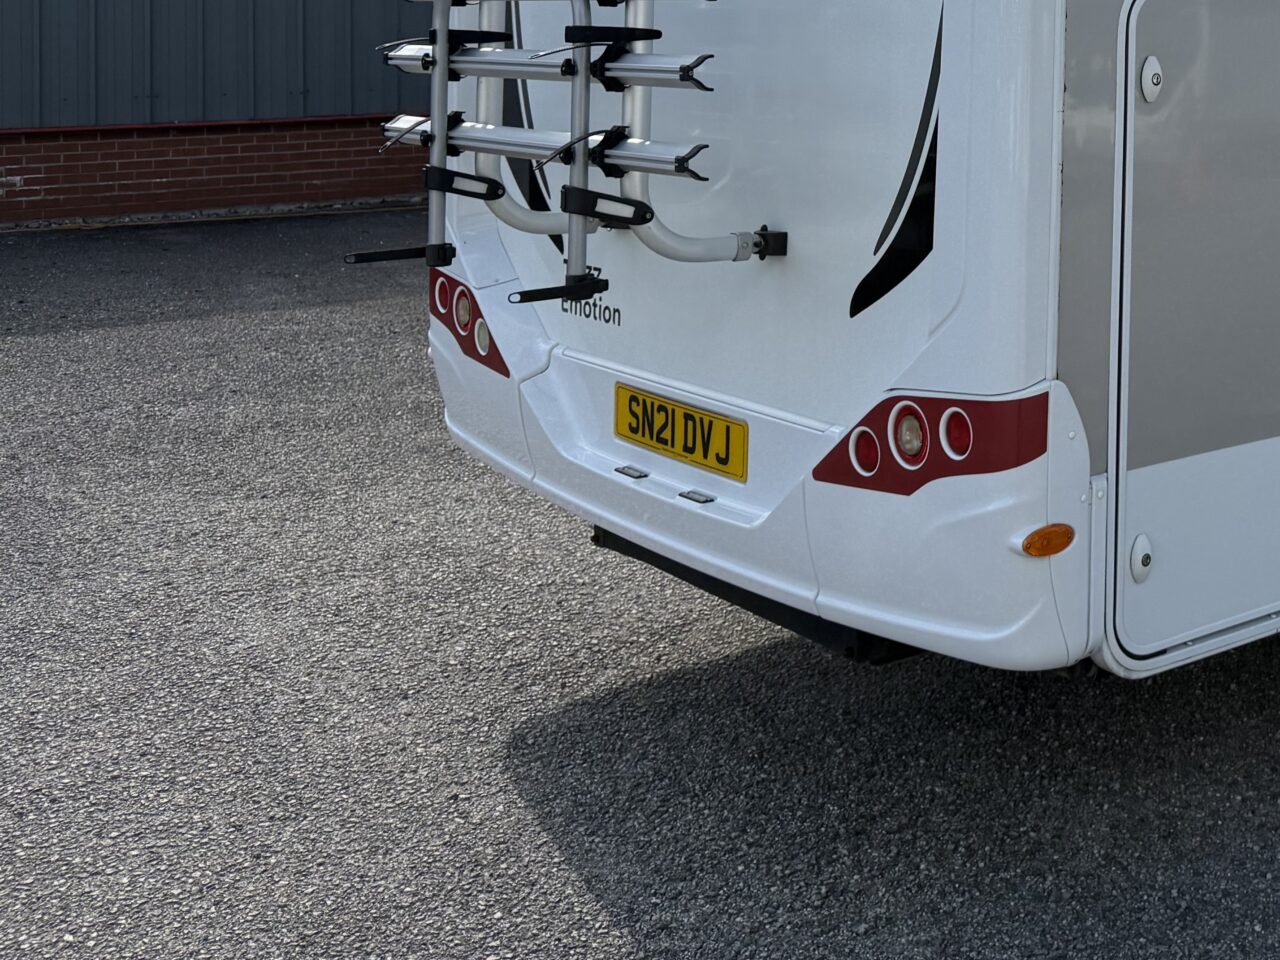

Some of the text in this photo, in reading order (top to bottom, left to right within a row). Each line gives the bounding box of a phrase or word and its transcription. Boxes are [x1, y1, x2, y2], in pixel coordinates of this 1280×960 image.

[561, 296, 621, 327] Emotion
[628, 394, 731, 466] SN21 DVJ
